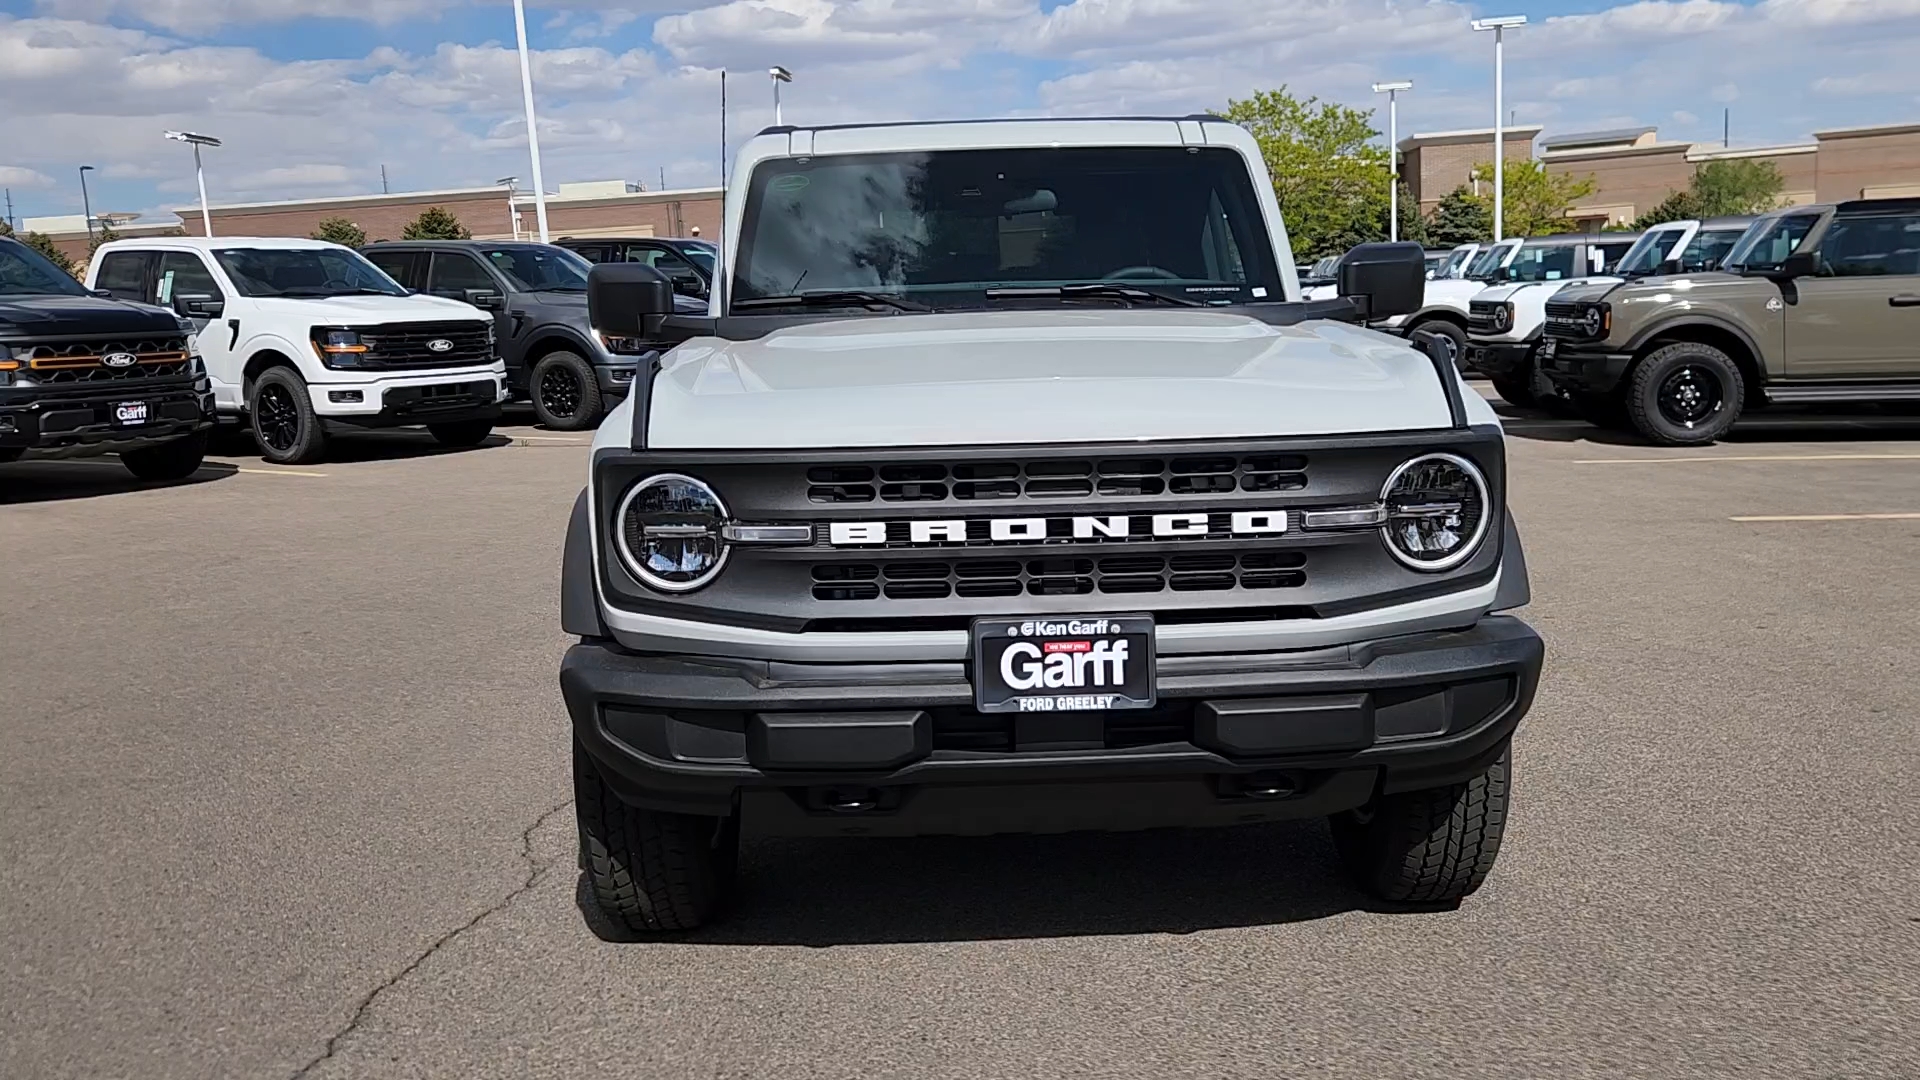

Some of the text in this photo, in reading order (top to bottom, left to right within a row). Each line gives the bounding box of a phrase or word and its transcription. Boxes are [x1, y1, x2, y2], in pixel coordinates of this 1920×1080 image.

[116, 405, 147, 420] Garff
[829, 511, 1287, 544] BRONCO
[1035, 620, 1109, 636] Ken Garff
[1000, 639, 1129, 690] Garff
[1019, 695, 1114, 712] FORD GREELEY
